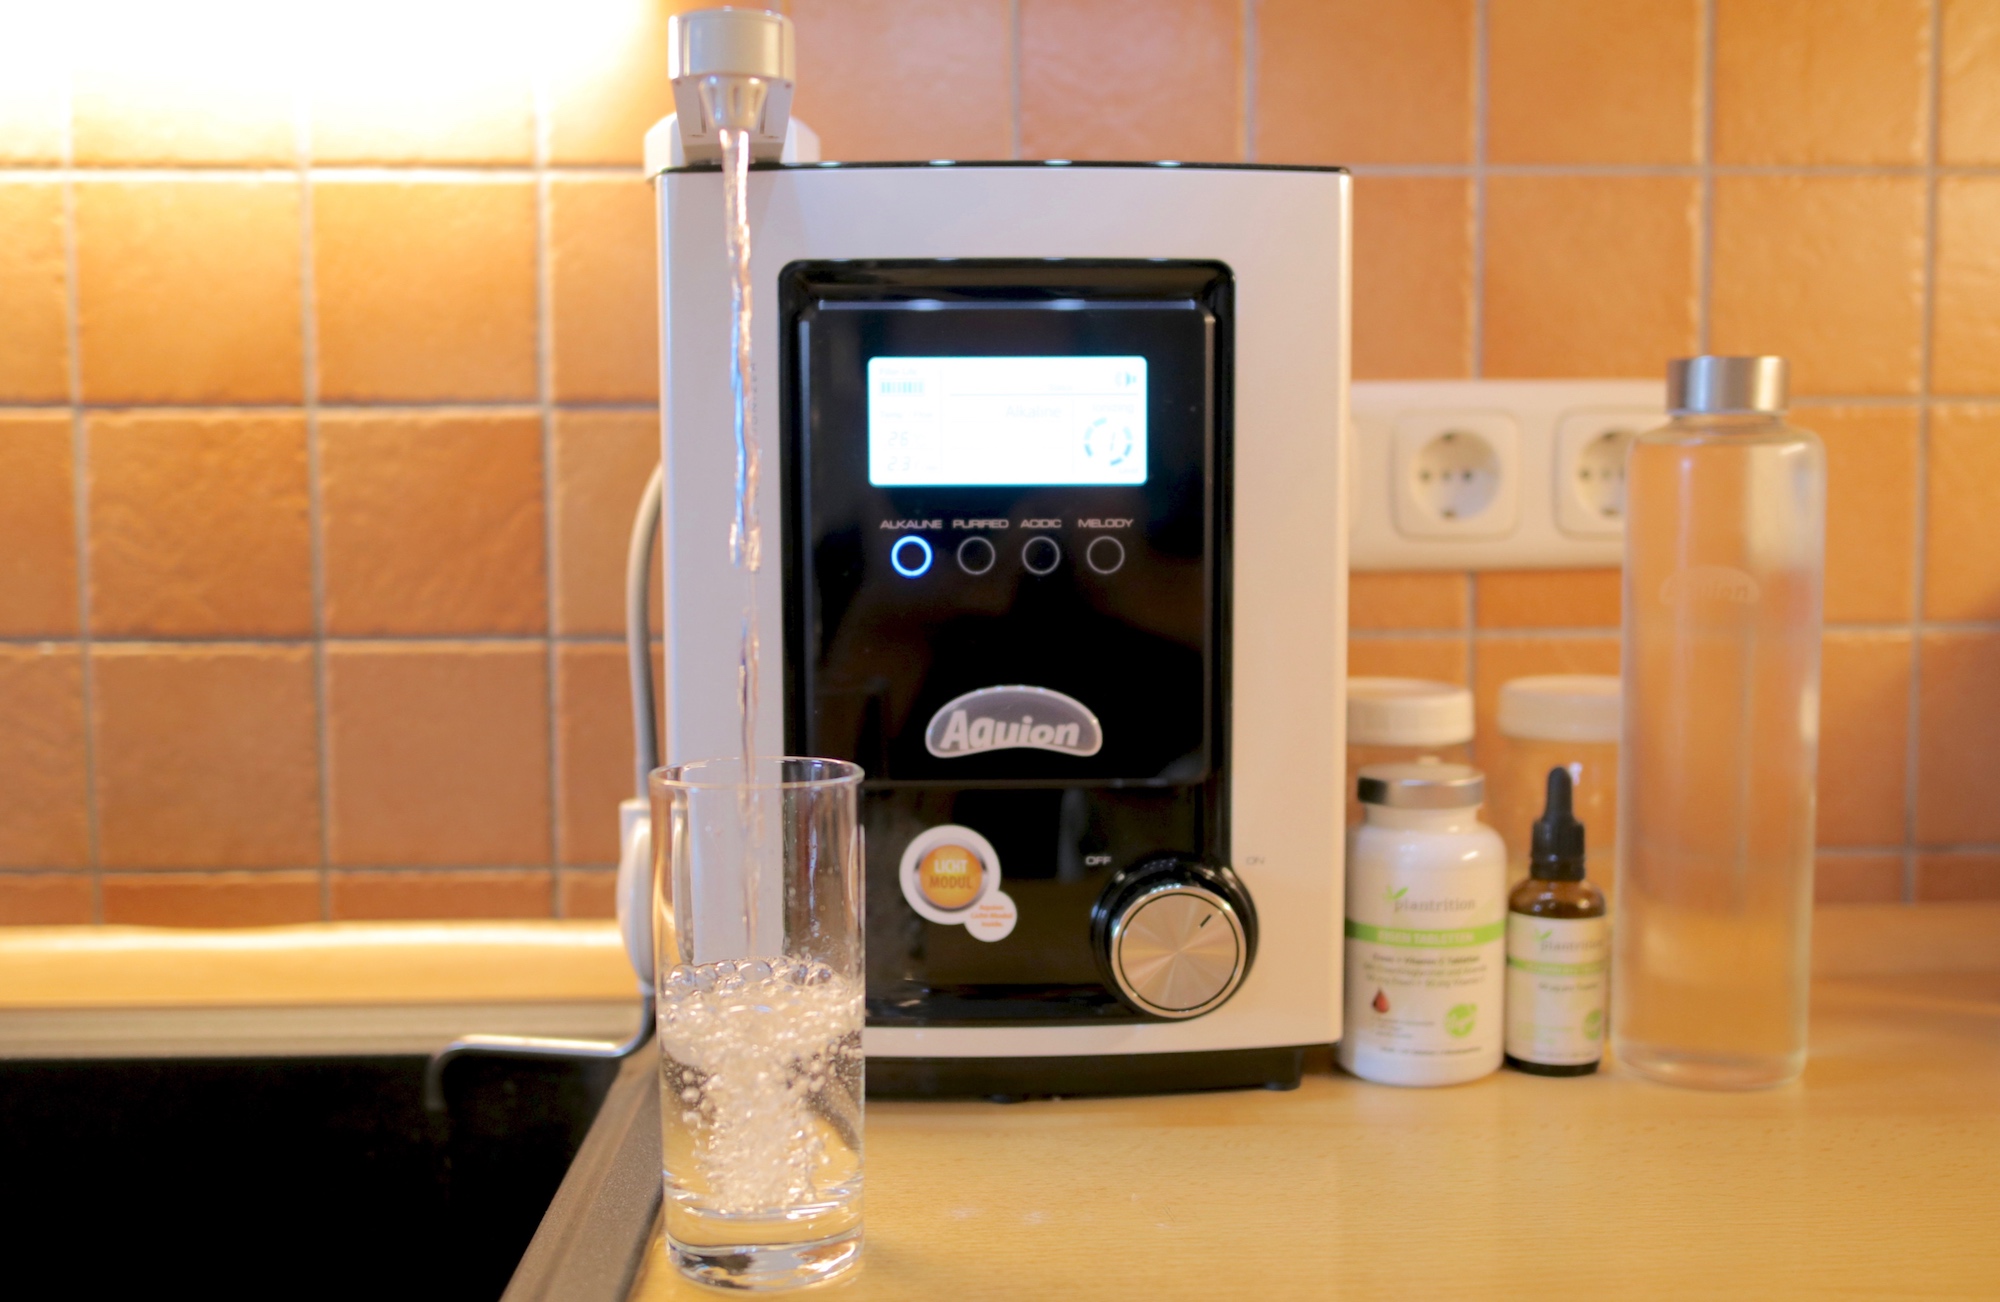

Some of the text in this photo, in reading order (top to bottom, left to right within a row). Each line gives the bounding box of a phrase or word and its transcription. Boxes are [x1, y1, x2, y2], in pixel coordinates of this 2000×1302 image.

[1005, 404, 1062, 419] Alkaline
[880, 519, 943, 529] ALKALINE
[1020, 518, 1062, 528] ACIDIC
[1077, 518, 1134, 528] MELODY
[939, 709, 1080, 751] Aquion
[1085, 855, 1111, 865] OFF
[1246, 856, 1265, 865] ON
[934, 858, 969, 875] LICHT
[929, 875, 973, 889] MODUL
[1394, 898, 1476, 913] plantrition
